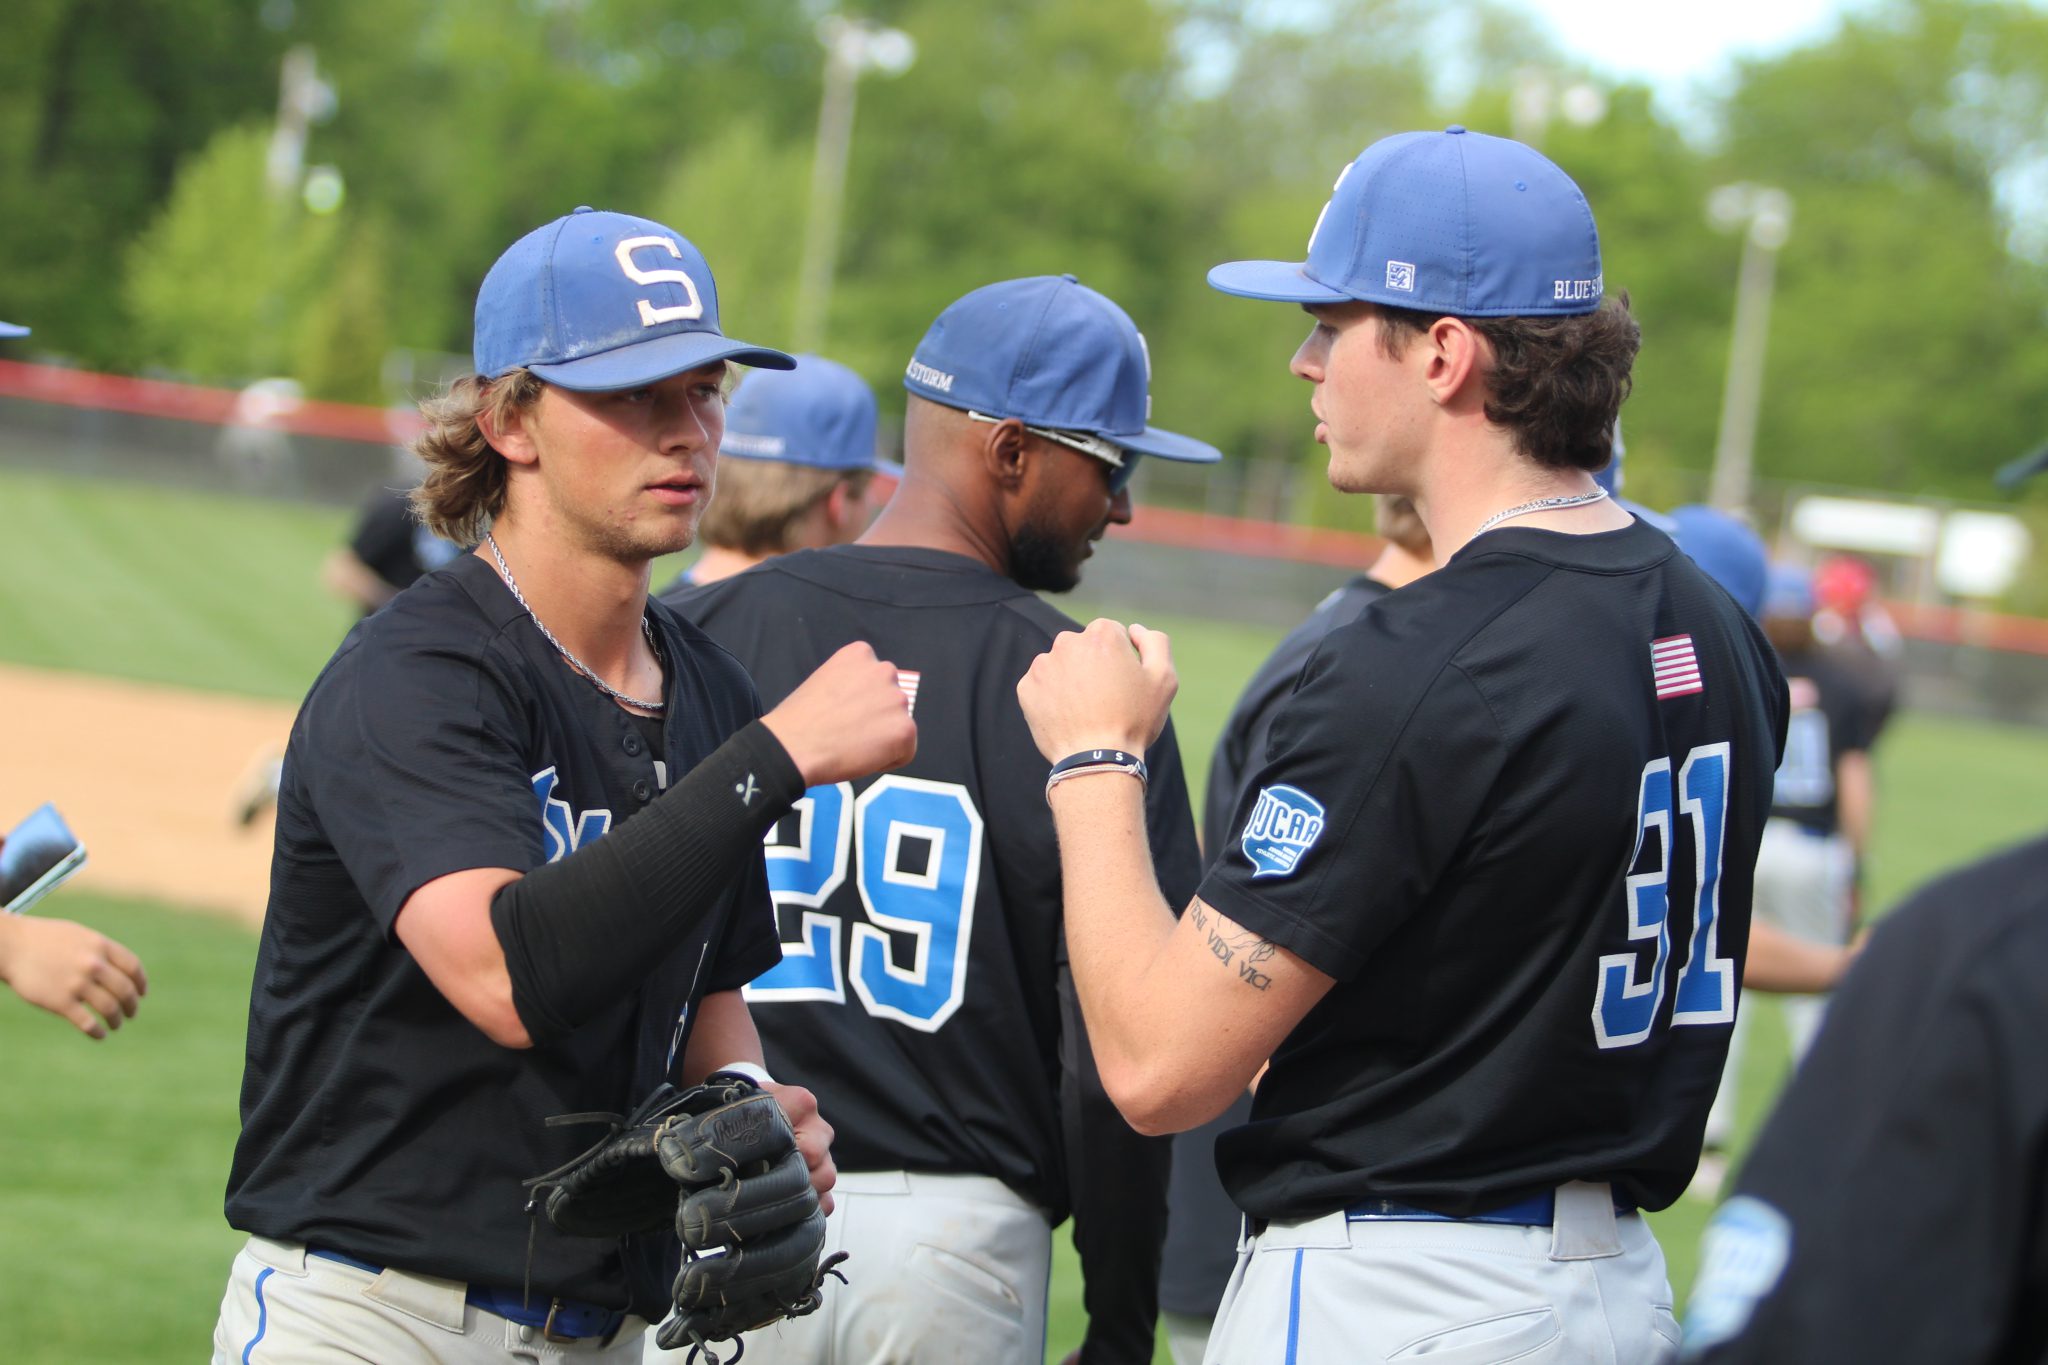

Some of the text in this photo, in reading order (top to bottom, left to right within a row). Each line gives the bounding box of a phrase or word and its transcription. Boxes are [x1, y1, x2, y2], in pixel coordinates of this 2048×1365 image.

[614, 236, 703, 327] S
[1553, 280, 1591, 299] BLUE
[741, 773, 984, 1033] 29
